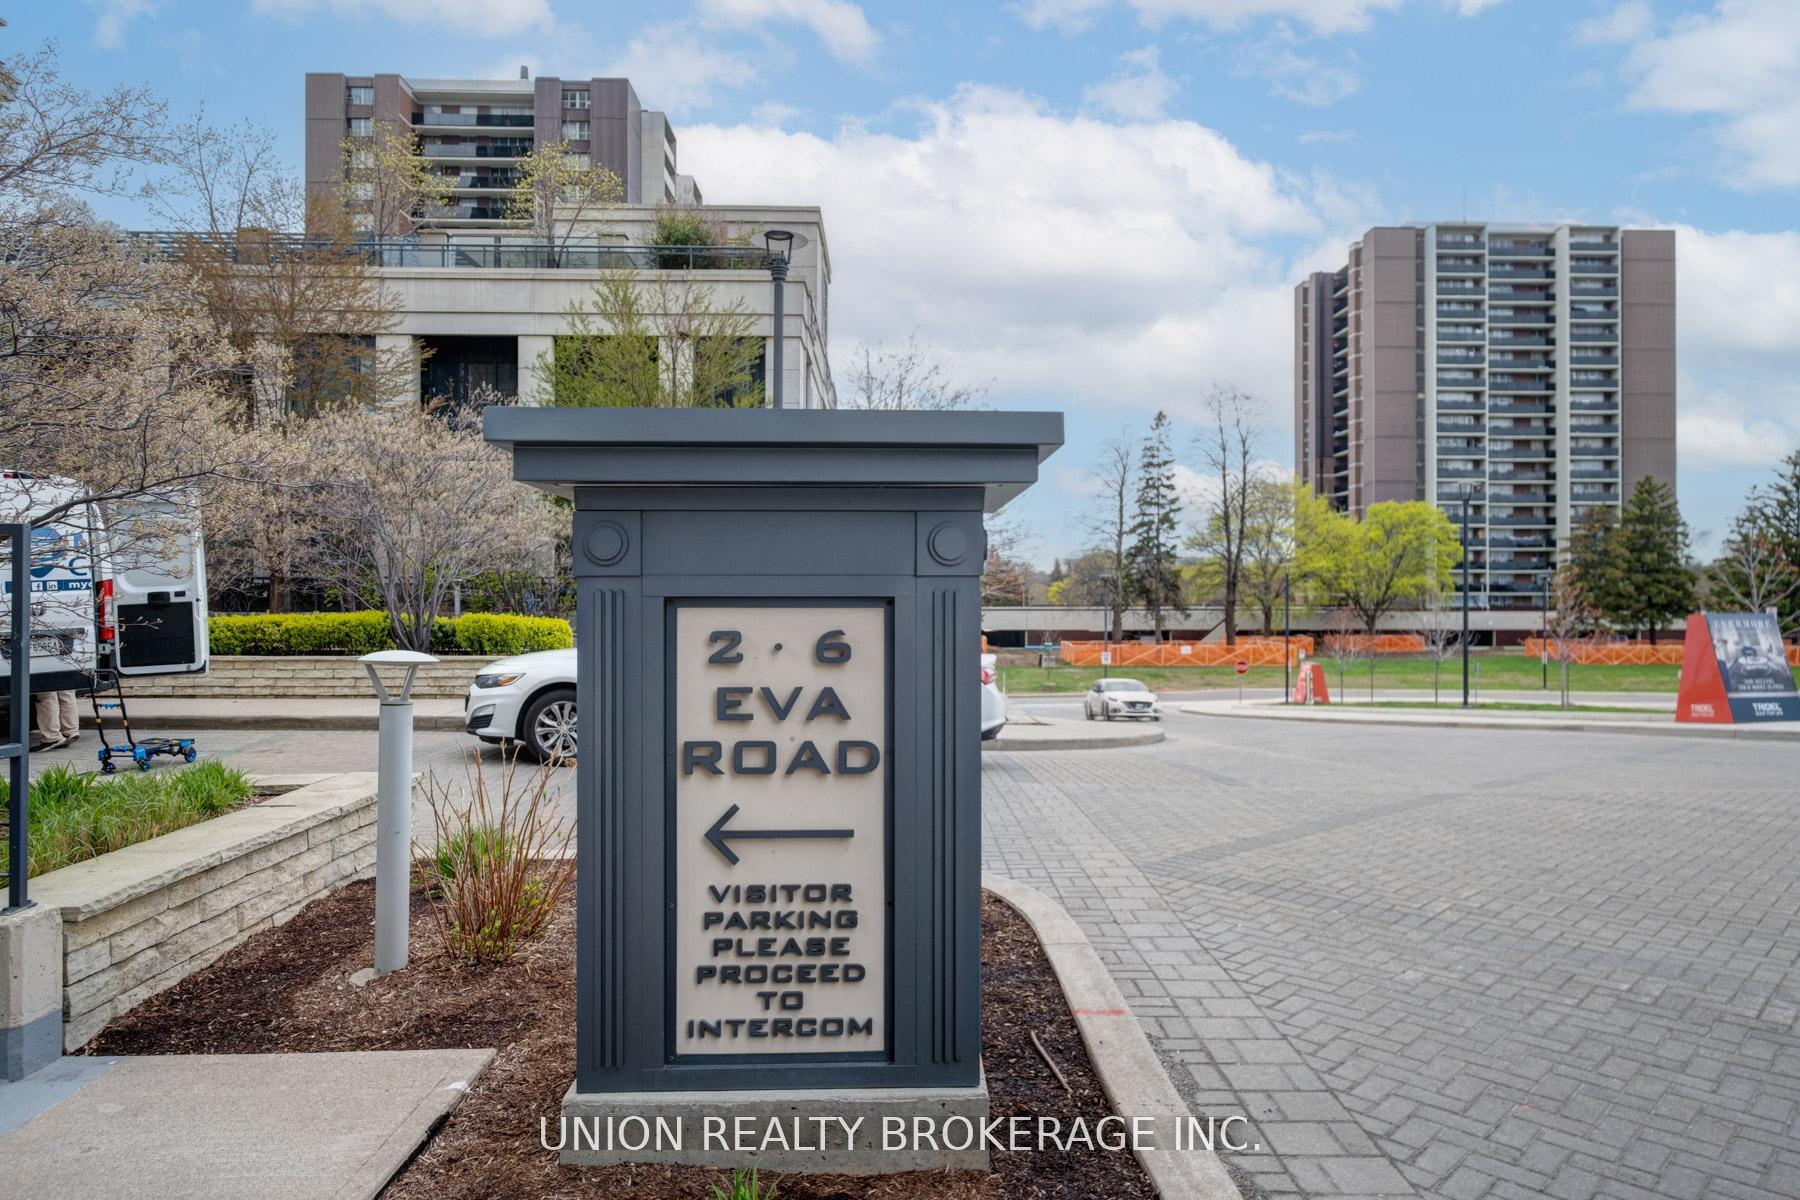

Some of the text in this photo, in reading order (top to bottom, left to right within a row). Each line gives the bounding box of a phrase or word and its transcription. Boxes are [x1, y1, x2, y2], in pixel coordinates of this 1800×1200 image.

[708, 630, 743, 664] 2
[816, 630, 851, 664] 6
[717, 687, 852, 720] EVA
[683, 741, 881, 775] ROAD
[709, 884, 853, 903] VISITOR
[703, 910, 858, 930] PARKING
[712, 937, 850, 956] PLEASE
[696, 964, 866, 984] PROCEED
[757, 991, 804, 1010] TO
[687, 1017, 873, 1038] INTERCOM
